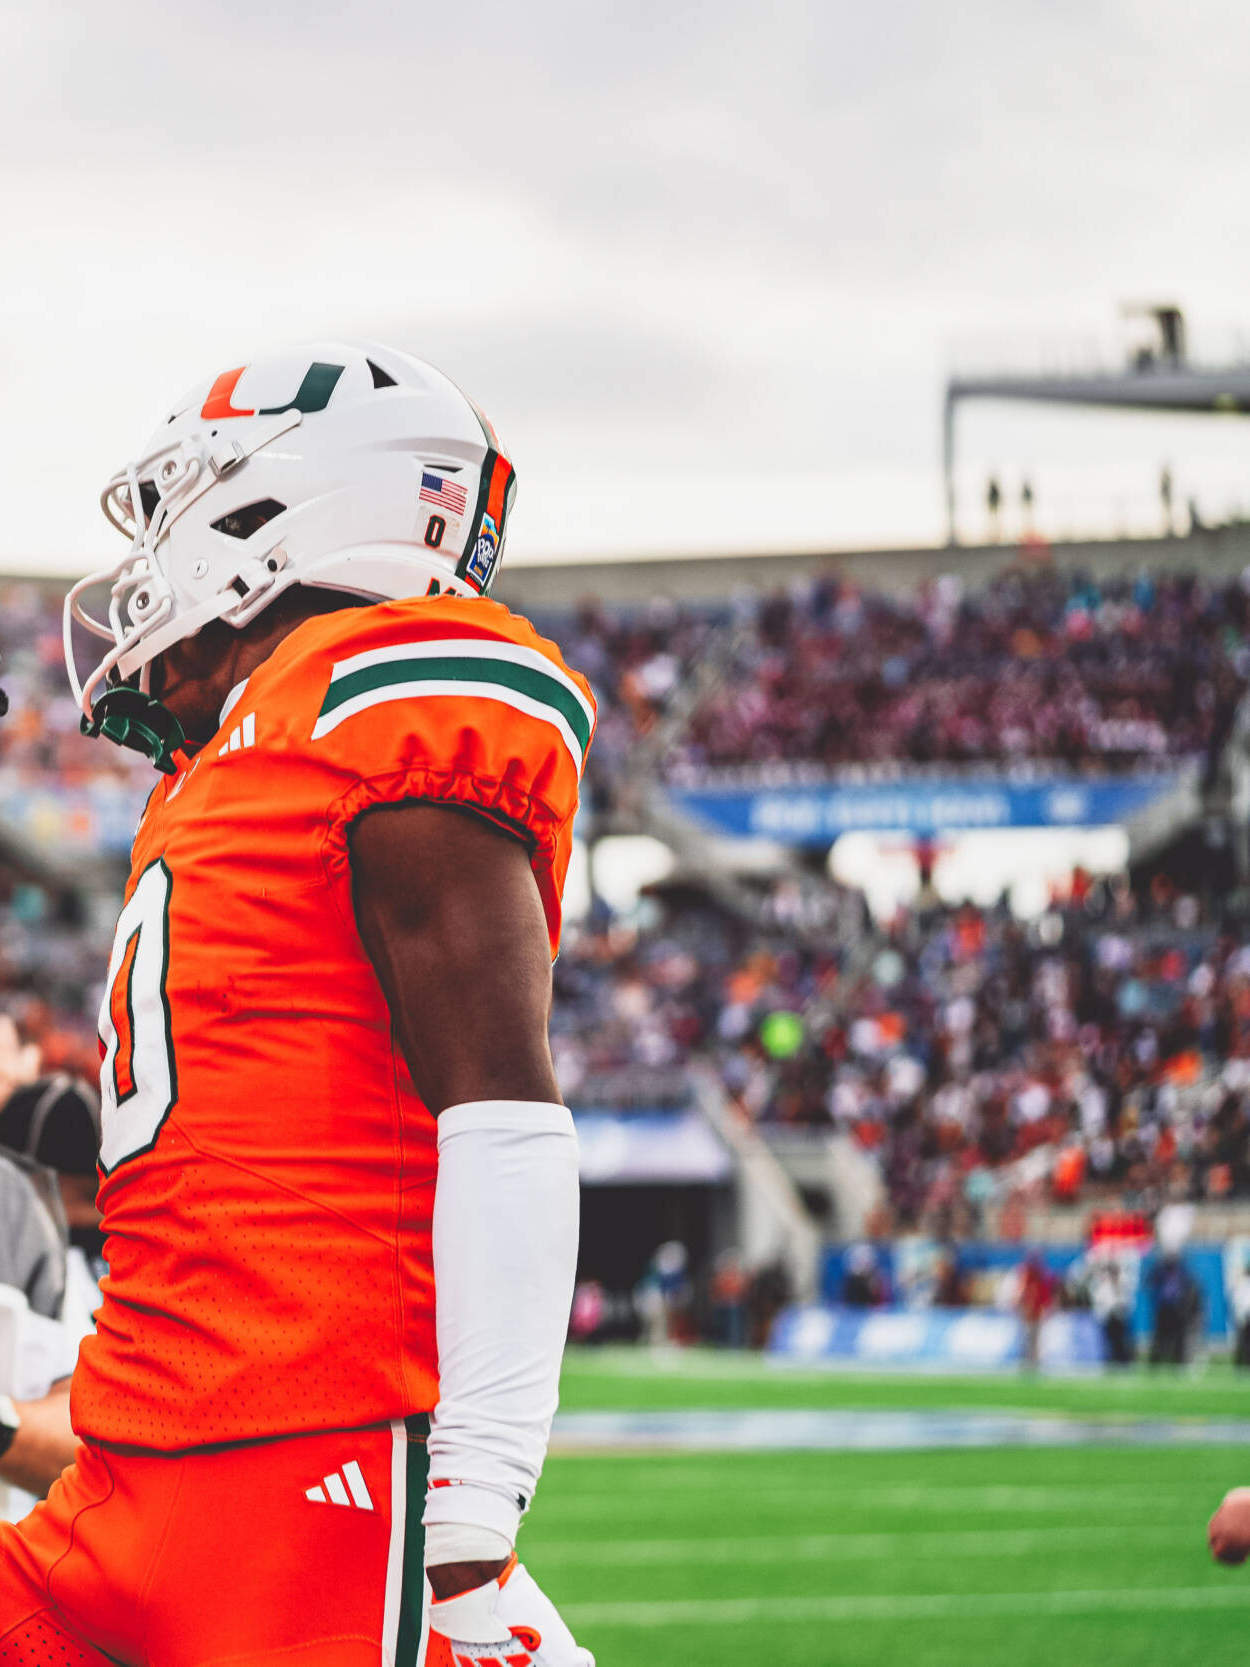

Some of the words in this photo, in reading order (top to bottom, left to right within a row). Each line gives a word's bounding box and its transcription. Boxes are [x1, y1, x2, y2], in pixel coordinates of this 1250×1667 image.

[200, 362, 345, 421] U
[424, 514, 446, 549] 0
[97, 856, 178, 1178] 0
